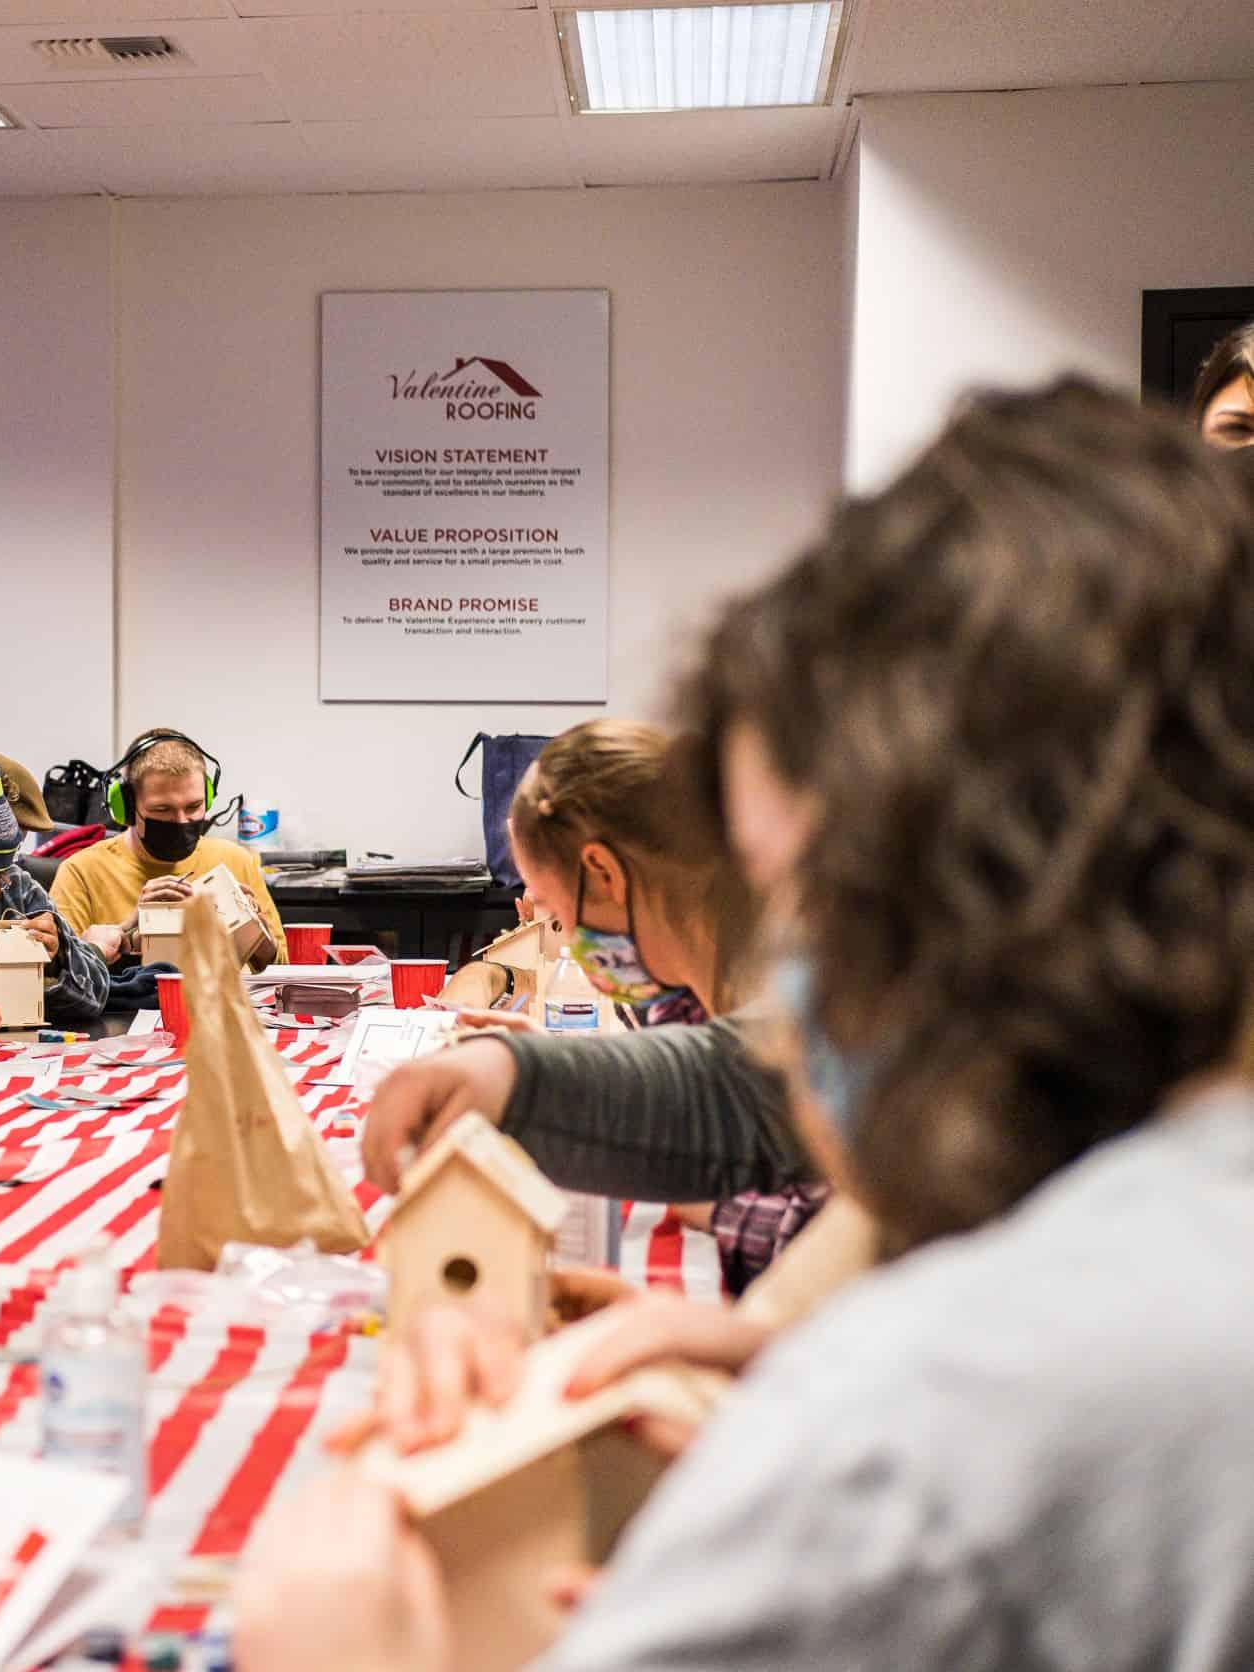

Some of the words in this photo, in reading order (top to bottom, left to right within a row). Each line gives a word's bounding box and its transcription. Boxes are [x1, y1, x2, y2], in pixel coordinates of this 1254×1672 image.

[386, 369, 501, 400] Valentine
[446, 402, 536, 420] ROOFING
[375, 449, 437, 463] VISION
[443, 449, 549, 463] STATEMENT
[348, 467, 359, 477] To
[361, 467, 372, 477] be
[374, 467, 422, 477] recognized
[425, 467, 437, 477] for
[439, 467, 454, 477] our
[456, 467, 493, 477] integrity
[496, 467, 512, 477] and
[514, 467, 548, 477] positive
[550, 467, 581, 477] impact
[353, 478, 363, 488] in
[365, 478, 380, 488] our
[382, 478, 432, 488] community,
[434, 478, 450, 488] and
[453, 478, 462, 488] to
[464, 478, 503, 488] establish
[505, 478, 546, 488] ourselves
[548, 478, 558, 488] as
[560, 478, 575, 488] the
[382, 488, 421, 497] standard
[423, 488, 432, 497] of
[434, 488, 480, 497] excellence
[482, 488, 490, 497] in
[492, 488, 506, 497] our
[508, 488, 545, 497] industry.
[370, 528, 428, 543] VALUE
[434, 528, 558, 543] PROPOSITION
[344, 547, 358, 556] We
[360, 547, 394, 556] provide
[396, 547, 410, 556] our
[413, 547, 457, 556] customers
[460, 547, 479, 556] with
[481, 547, 486, 556] a
[488, 547, 510, 556] large
[513, 547, 552, 556] premium
[554, 547, 562, 556] in
[564, 547, 585, 556] both
[362, 557, 391, 567] quality
[394, 557, 410, 567] and
[412, 557, 443, 567] service
[445, 557, 457, 567] for
[460, 557, 466, 567] a
[468, 557, 490, 567] small
[492, 557, 531, 567] premium
[533, 557, 541, 567] in
[543, 557, 563, 567] cost.
[389, 598, 453, 612] BRAND
[459, 598, 539, 612] PROMISE
[343, 616, 352, 625] To
[355, 616, 384, 625] deliver
[387, 616, 402, 625] The
[405, 616, 445, 625] Valentine
[448, 616, 496, 625] Experience
[498, 616, 517, 625] with
[519, 616, 543, 625] every
[546, 616, 586, 625] customer
[404, 627, 453, 635] transaction
[455, 627, 472, 635] and
[474, 627, 523, 635] interaction.
